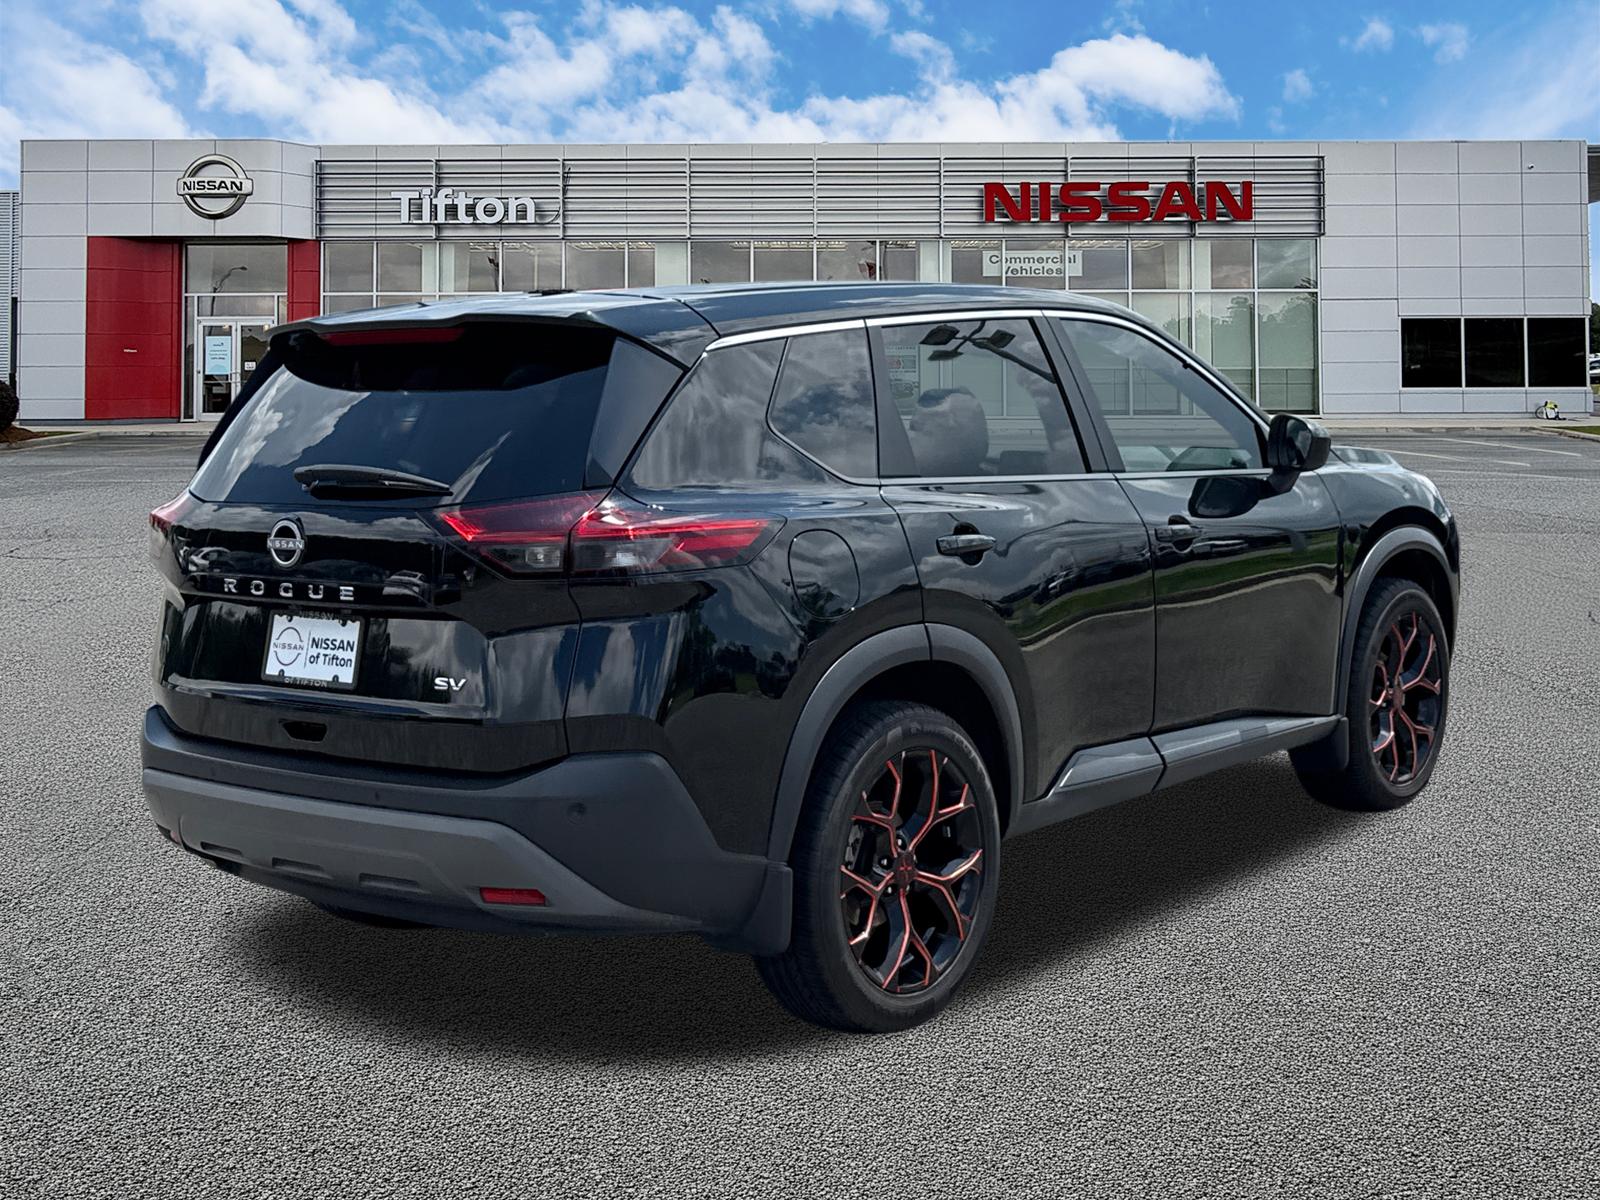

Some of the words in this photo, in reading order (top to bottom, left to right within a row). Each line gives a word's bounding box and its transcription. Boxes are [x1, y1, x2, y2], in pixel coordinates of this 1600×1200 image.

[183, 180, 243, 191] NISSAN
[391, 187, 536, 224] Tifton
[984, 181, 1253, 222] NISSAN
[223, 578, 354, 600] ROGUE
[272, 642, 304, 651] NISSAN
[311, 637, 355, 652] NISSAN
[309, 653, 320, 664] of
[322, 654, 352, 667] Tifton
[434, 677, 467, 690] SV
